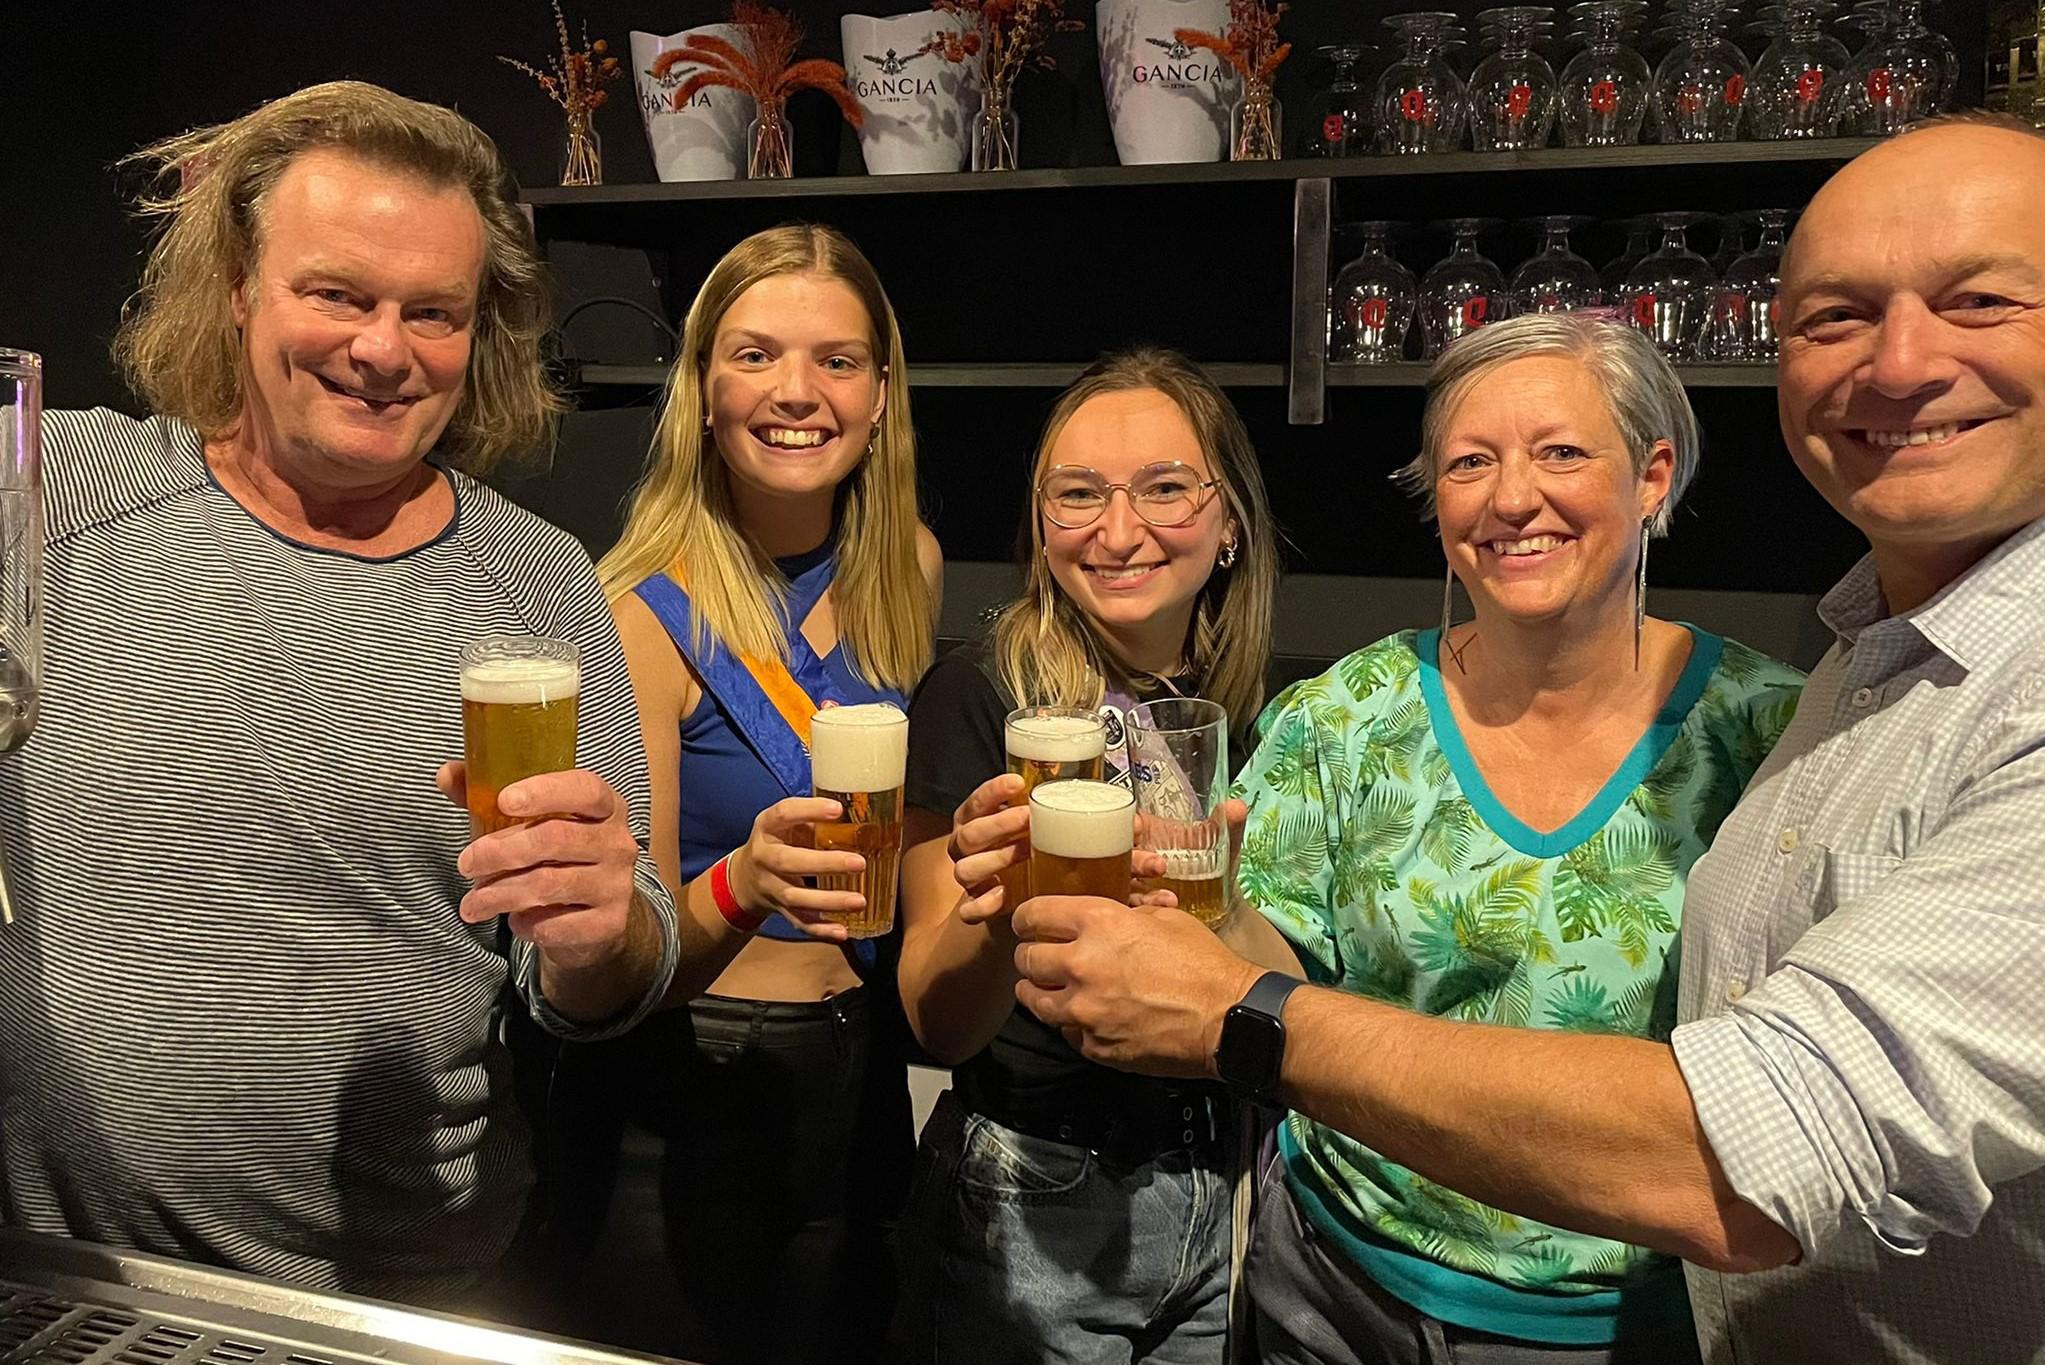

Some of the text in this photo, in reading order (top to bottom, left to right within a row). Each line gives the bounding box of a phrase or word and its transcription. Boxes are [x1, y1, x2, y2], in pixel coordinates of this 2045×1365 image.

[1132, 63, 1222, 83] GANCIA
[857, 78, 937, 98] GANCIA
[641, 91, 712, 111] GANIA
